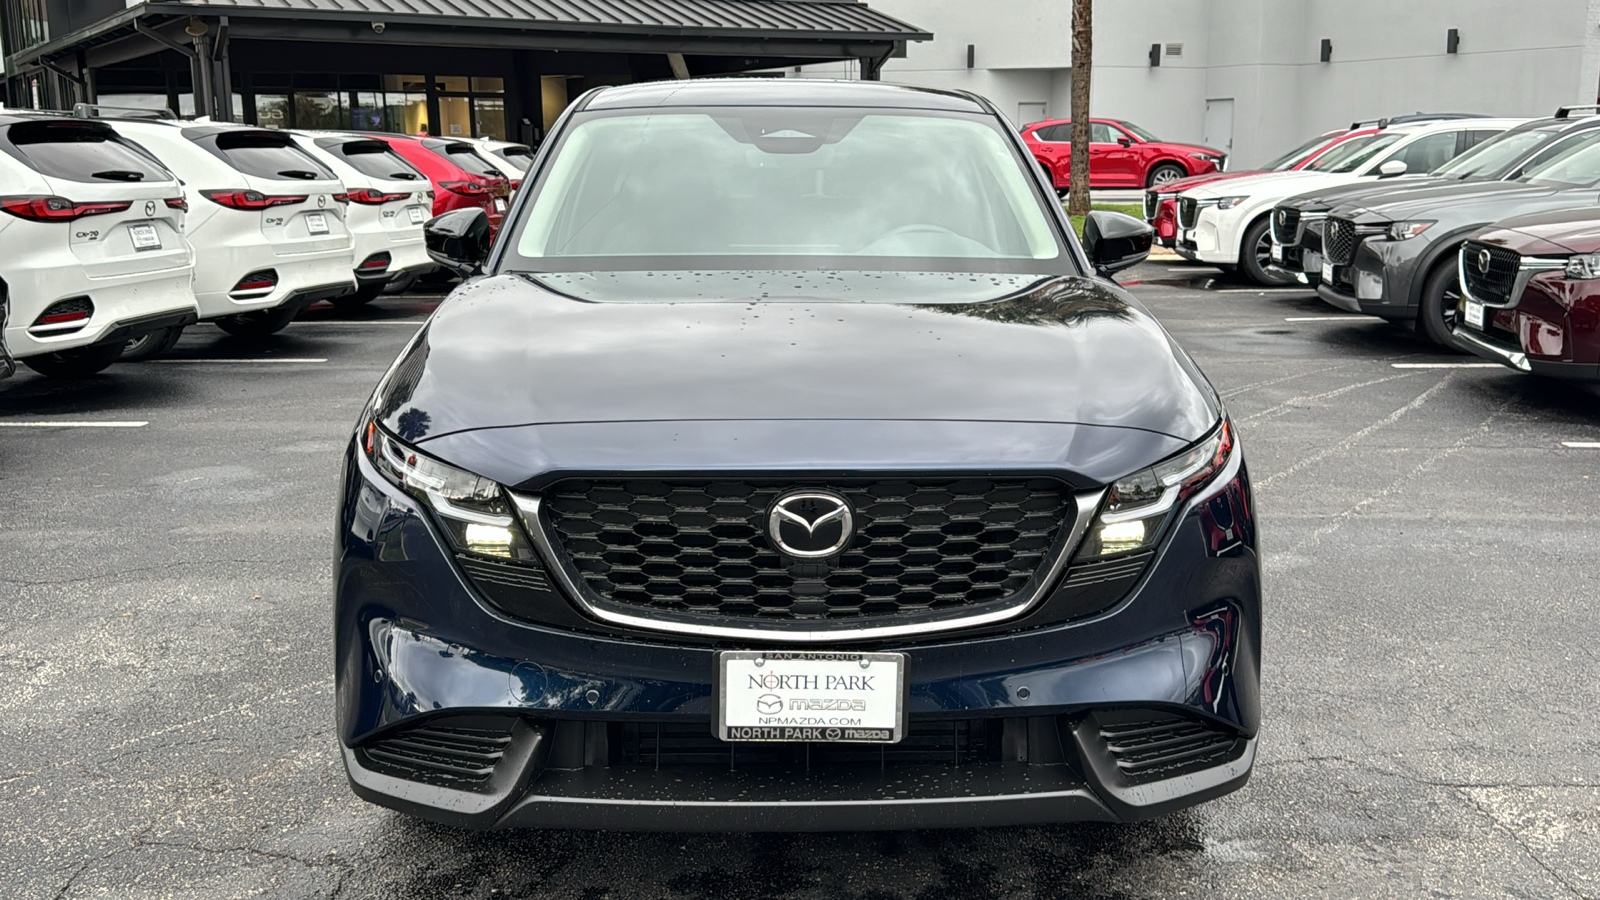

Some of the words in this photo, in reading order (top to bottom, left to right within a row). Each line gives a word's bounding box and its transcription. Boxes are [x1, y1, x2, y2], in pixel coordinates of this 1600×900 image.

[76, 230, 99, 238] CX-70
[747, 673, 819, 691] NORTH
[825, 674, 876, 691] PARK
[789, 698, 866, 711] mazda
[758, 717, 862, 726] NPMAZDA.COM
[731, 727, 780, 739] NORTH
[784, 728, 822, 739] PARK
[845, 730, 890, 740] mazda
